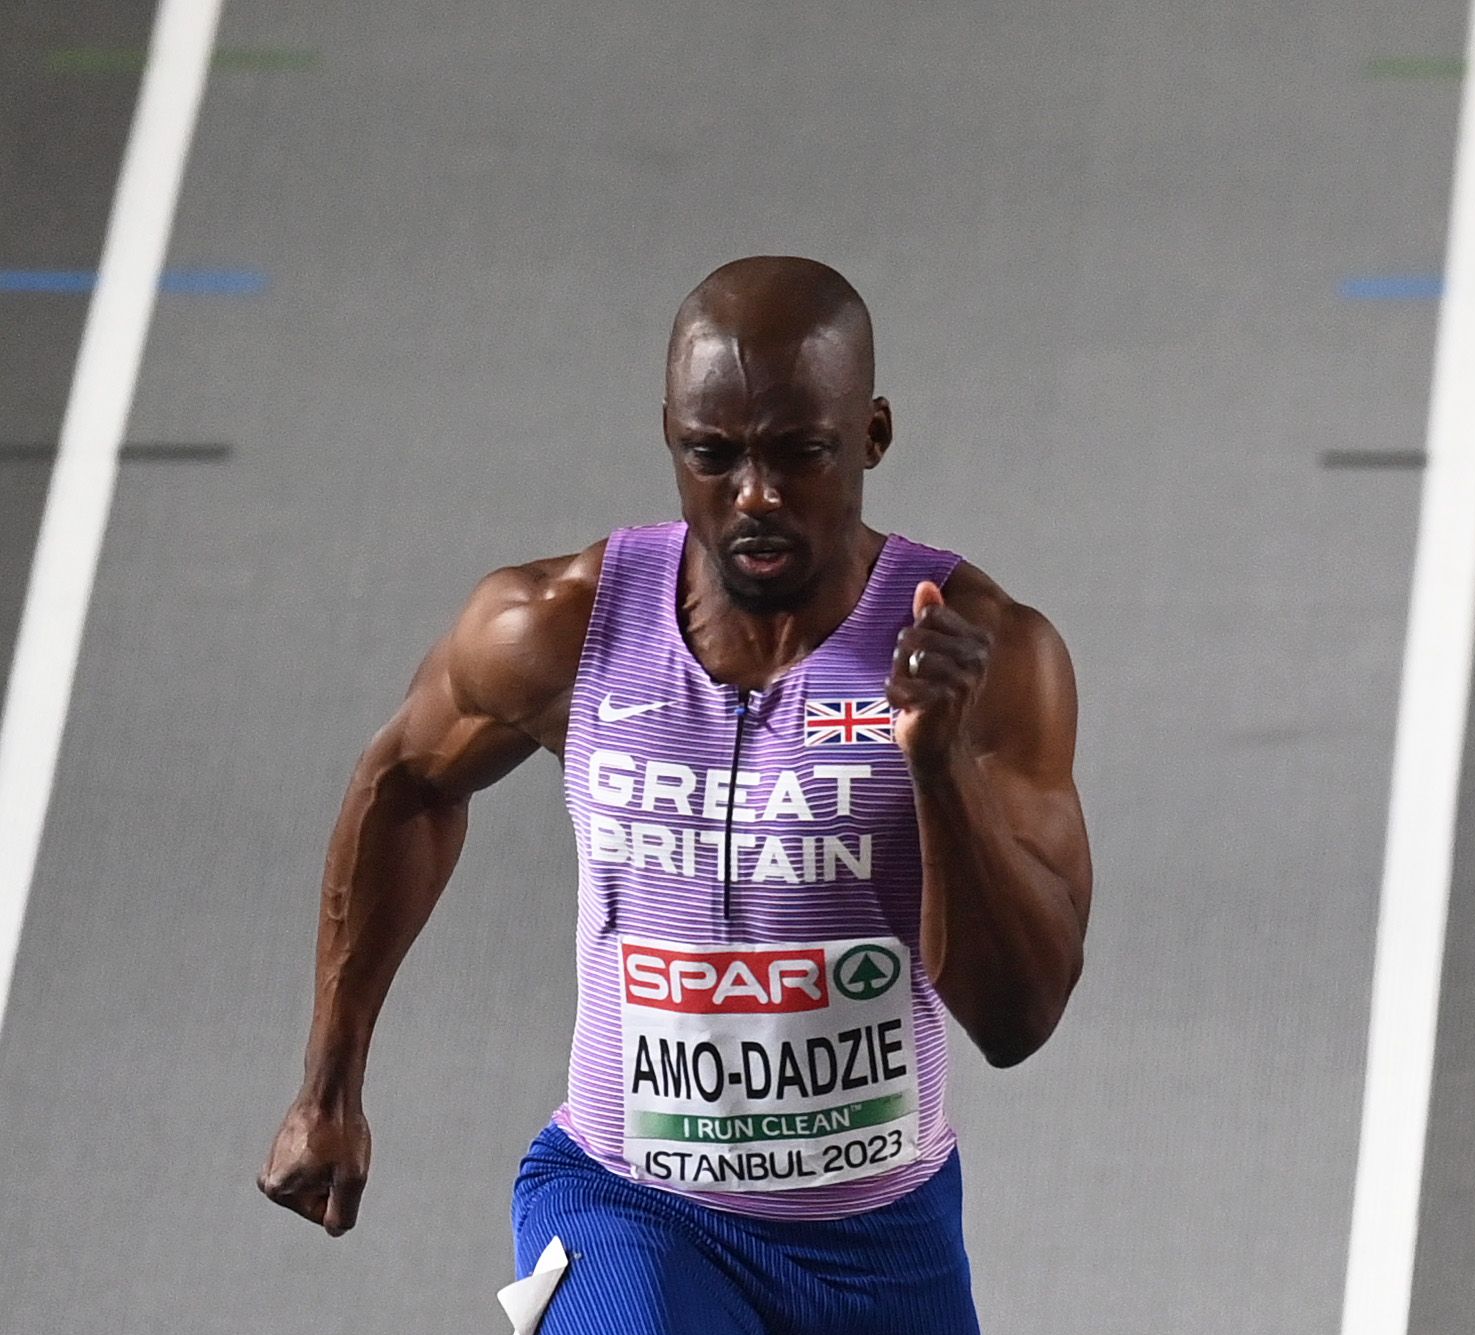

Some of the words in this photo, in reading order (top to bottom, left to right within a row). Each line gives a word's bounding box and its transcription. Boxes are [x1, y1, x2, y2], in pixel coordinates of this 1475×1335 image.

[588, 749, 872, 823] GREAT
[590, 812, 872, 884] BRITAIN
[625, 953, 822, 1005] SPAR
[632, 1018, 907, 1103] AMO-DADZIE
[645, 1147, 816, 1182] ISTANBUL
[823, 1129, 903, 1174] 2023
[683, 1117, 690, 1137] I
[698, 1117, 753, 1140] RUN
